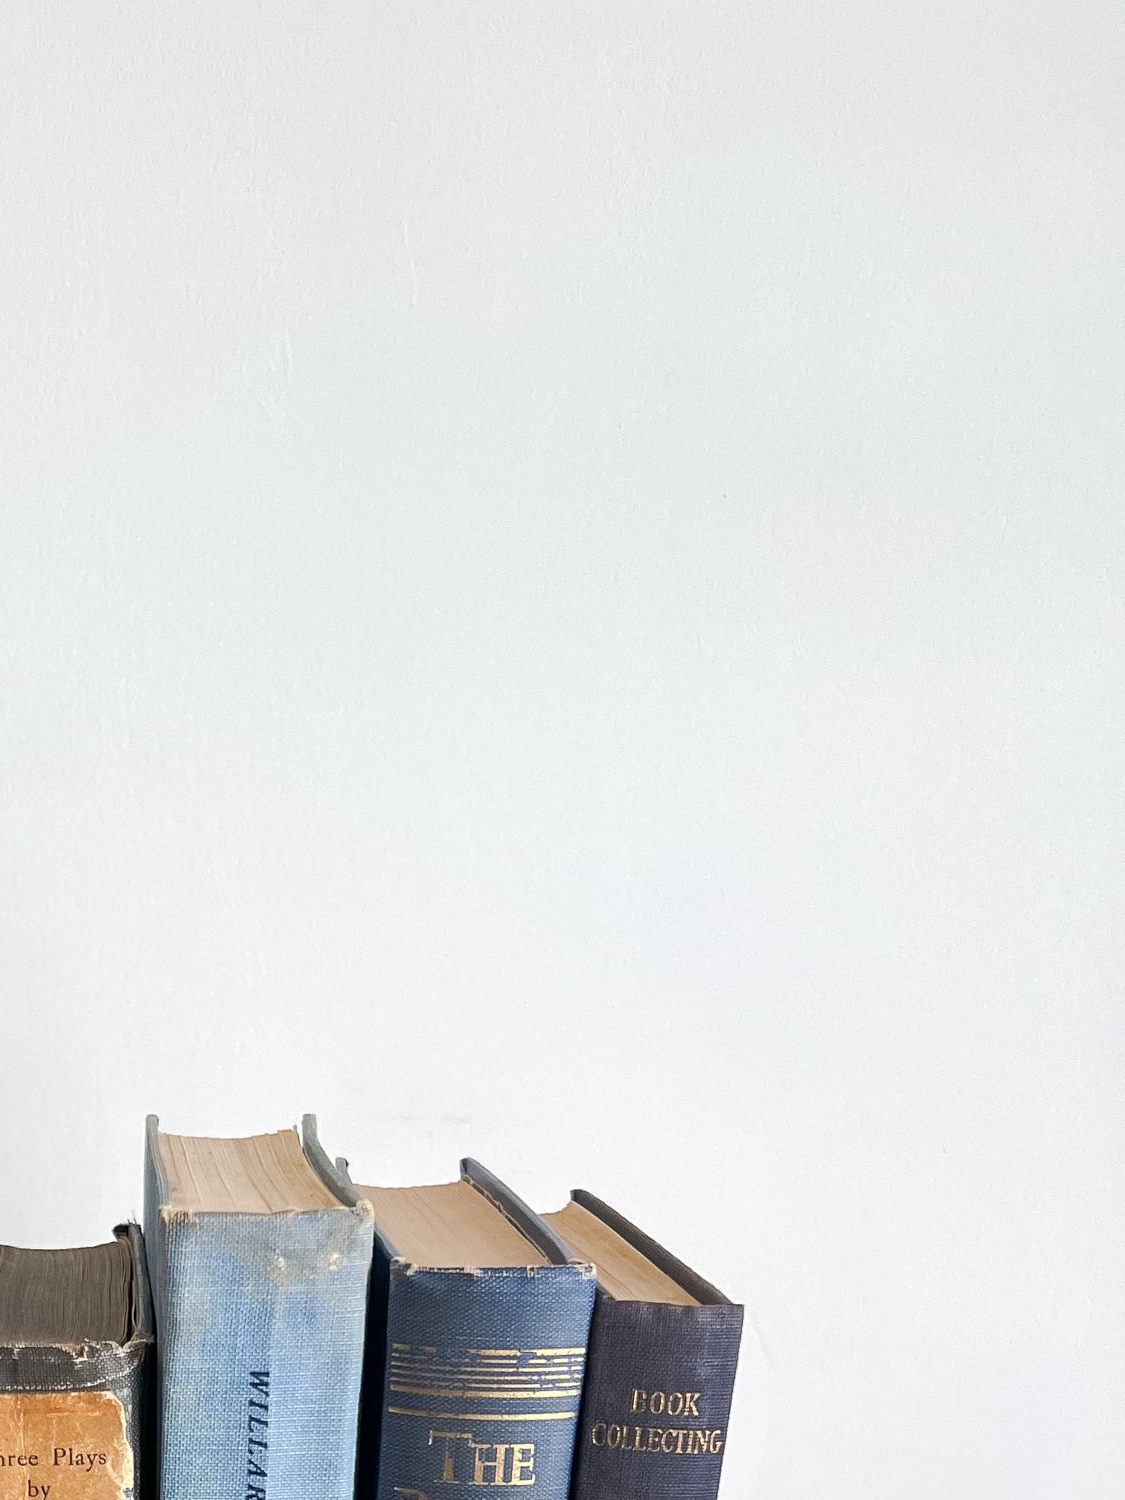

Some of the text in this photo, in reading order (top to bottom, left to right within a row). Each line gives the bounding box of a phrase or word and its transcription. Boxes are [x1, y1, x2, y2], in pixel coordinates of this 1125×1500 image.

[630, 1387, 701, 1417] BOOK
[591, 1423, 724, 1455] COLLECTING
[53, 1448, 107, 1467] Plays
[428, 1430, 536, 1486] THE
